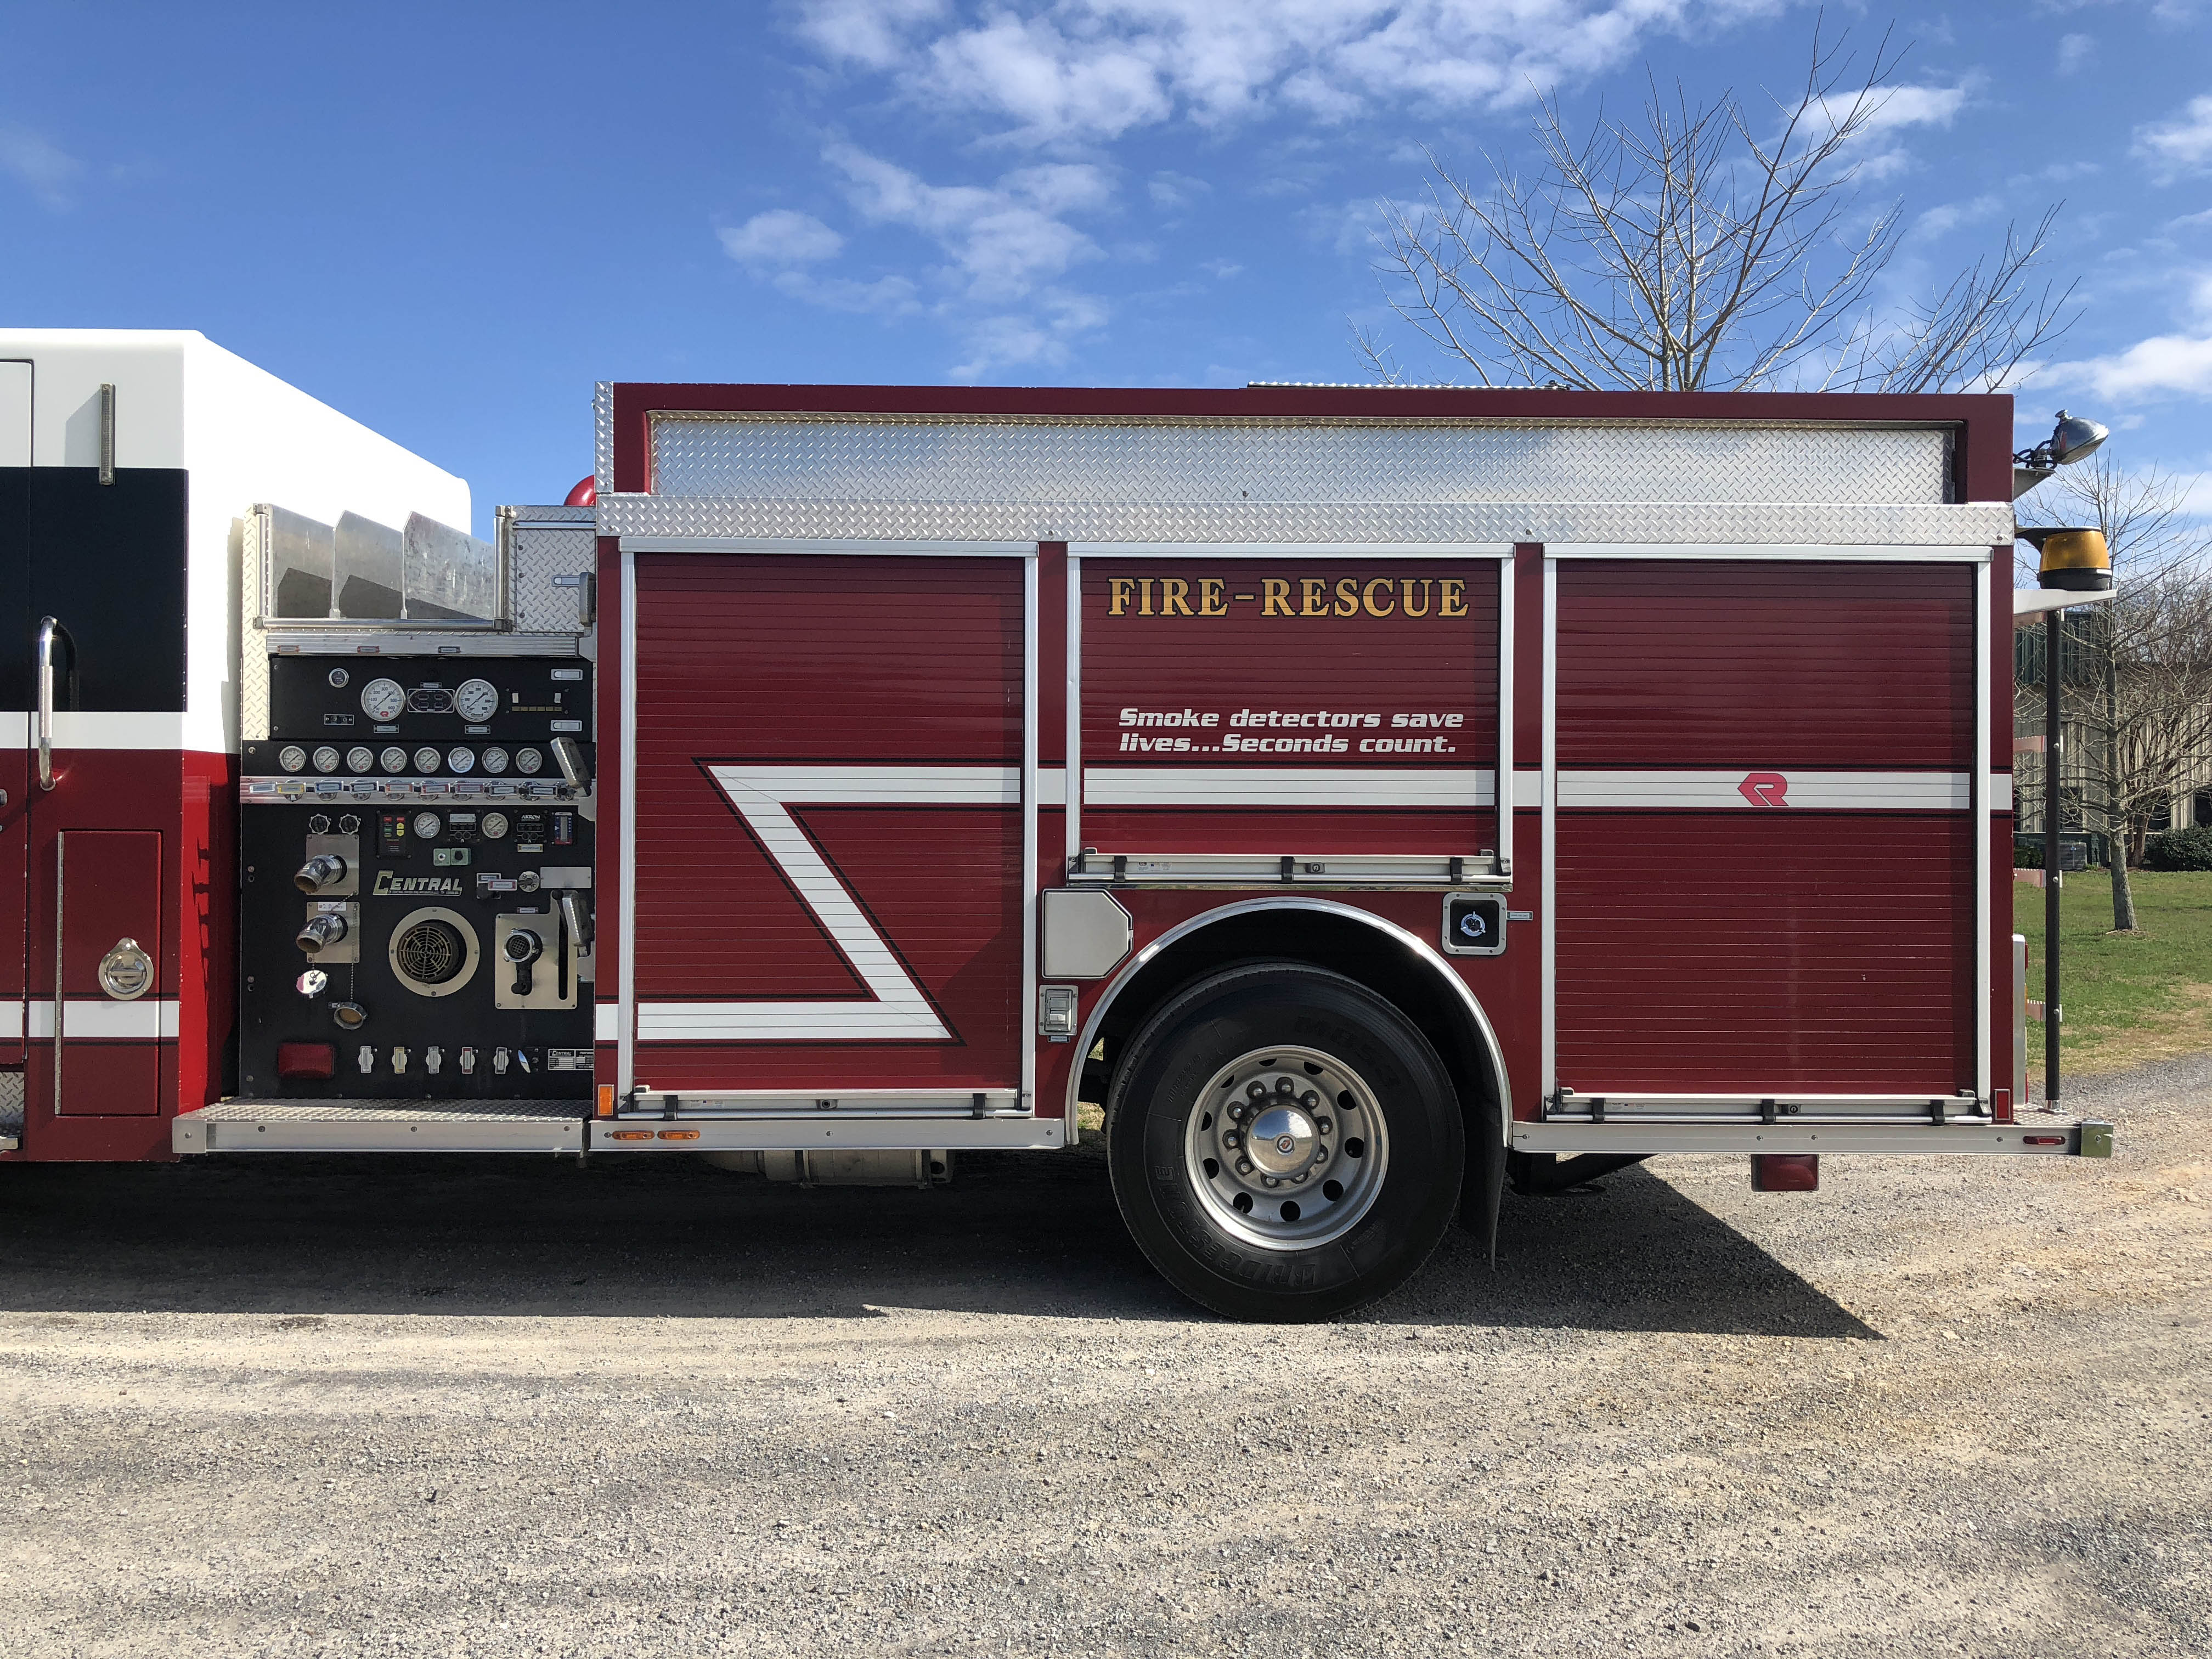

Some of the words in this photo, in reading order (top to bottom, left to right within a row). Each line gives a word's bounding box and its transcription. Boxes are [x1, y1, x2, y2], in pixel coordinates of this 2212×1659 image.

[1108, 578, 1469, 617] FIRE-RESCUE
[1119, 708, 1220, 727] Smoke
[1229, 708, 1381, 727] detectors
[1391, 713, 1464, 727] save
[1359, 736, 1456, 753] count.
[373, 870, 463, 895] CENTRAL
